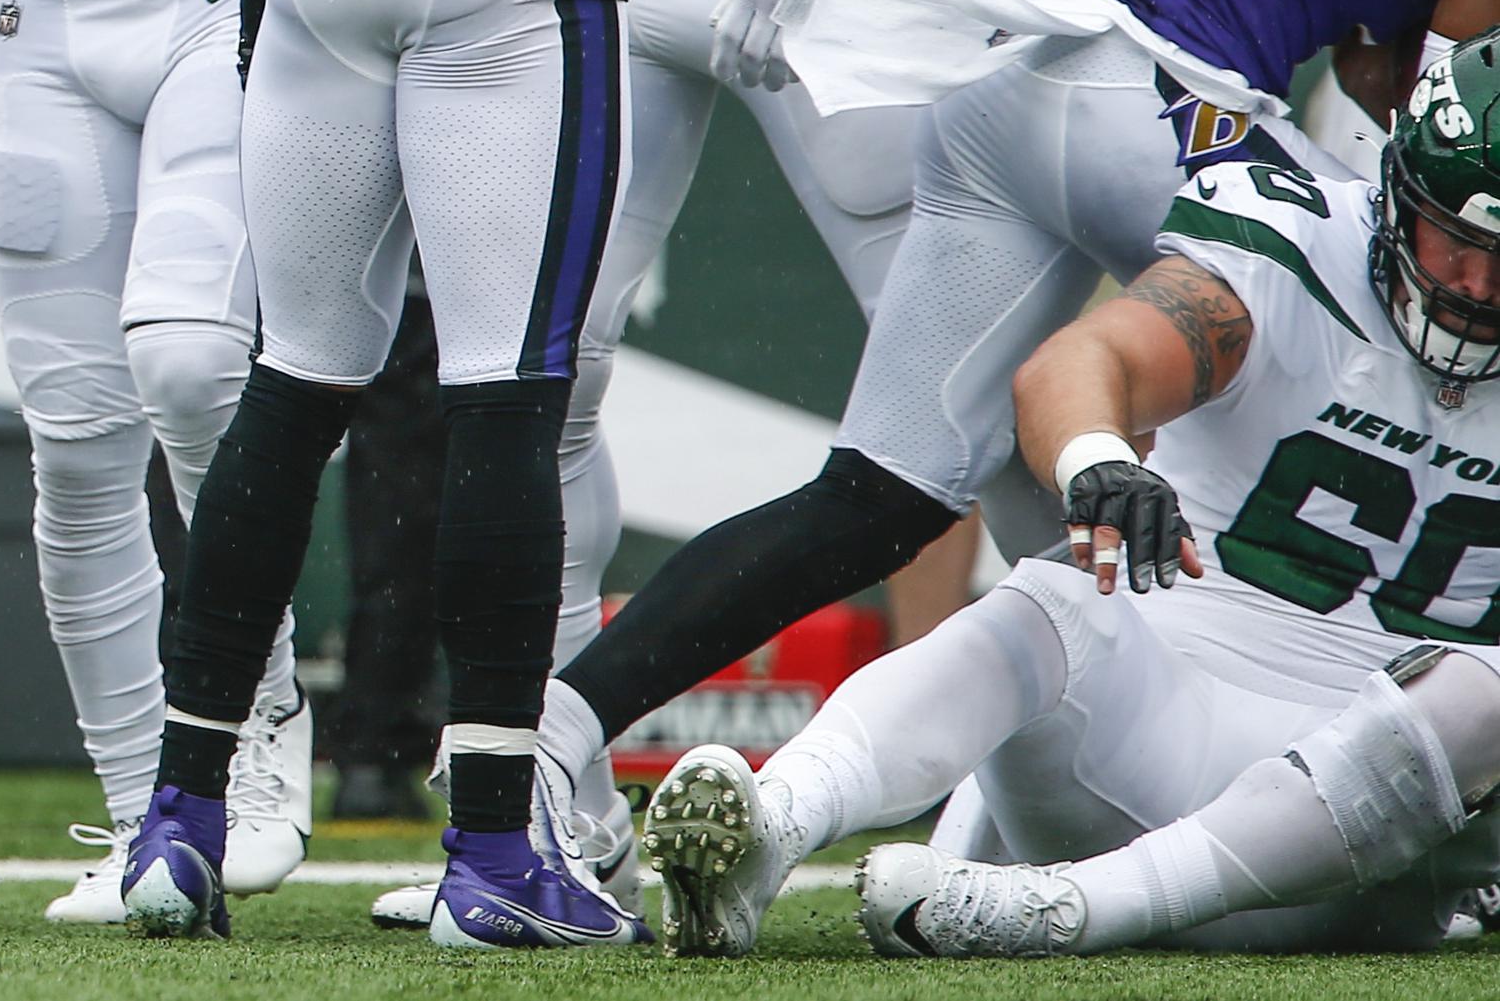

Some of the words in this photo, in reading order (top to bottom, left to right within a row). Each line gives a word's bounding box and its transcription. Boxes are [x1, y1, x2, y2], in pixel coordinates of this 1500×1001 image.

[1426, 54, 1476, 140] ETS
[1316, 401, 1434, 455] NEW
[1428, 443, 1500, 486] YO
[1215, 430, 1500, 646] 60
